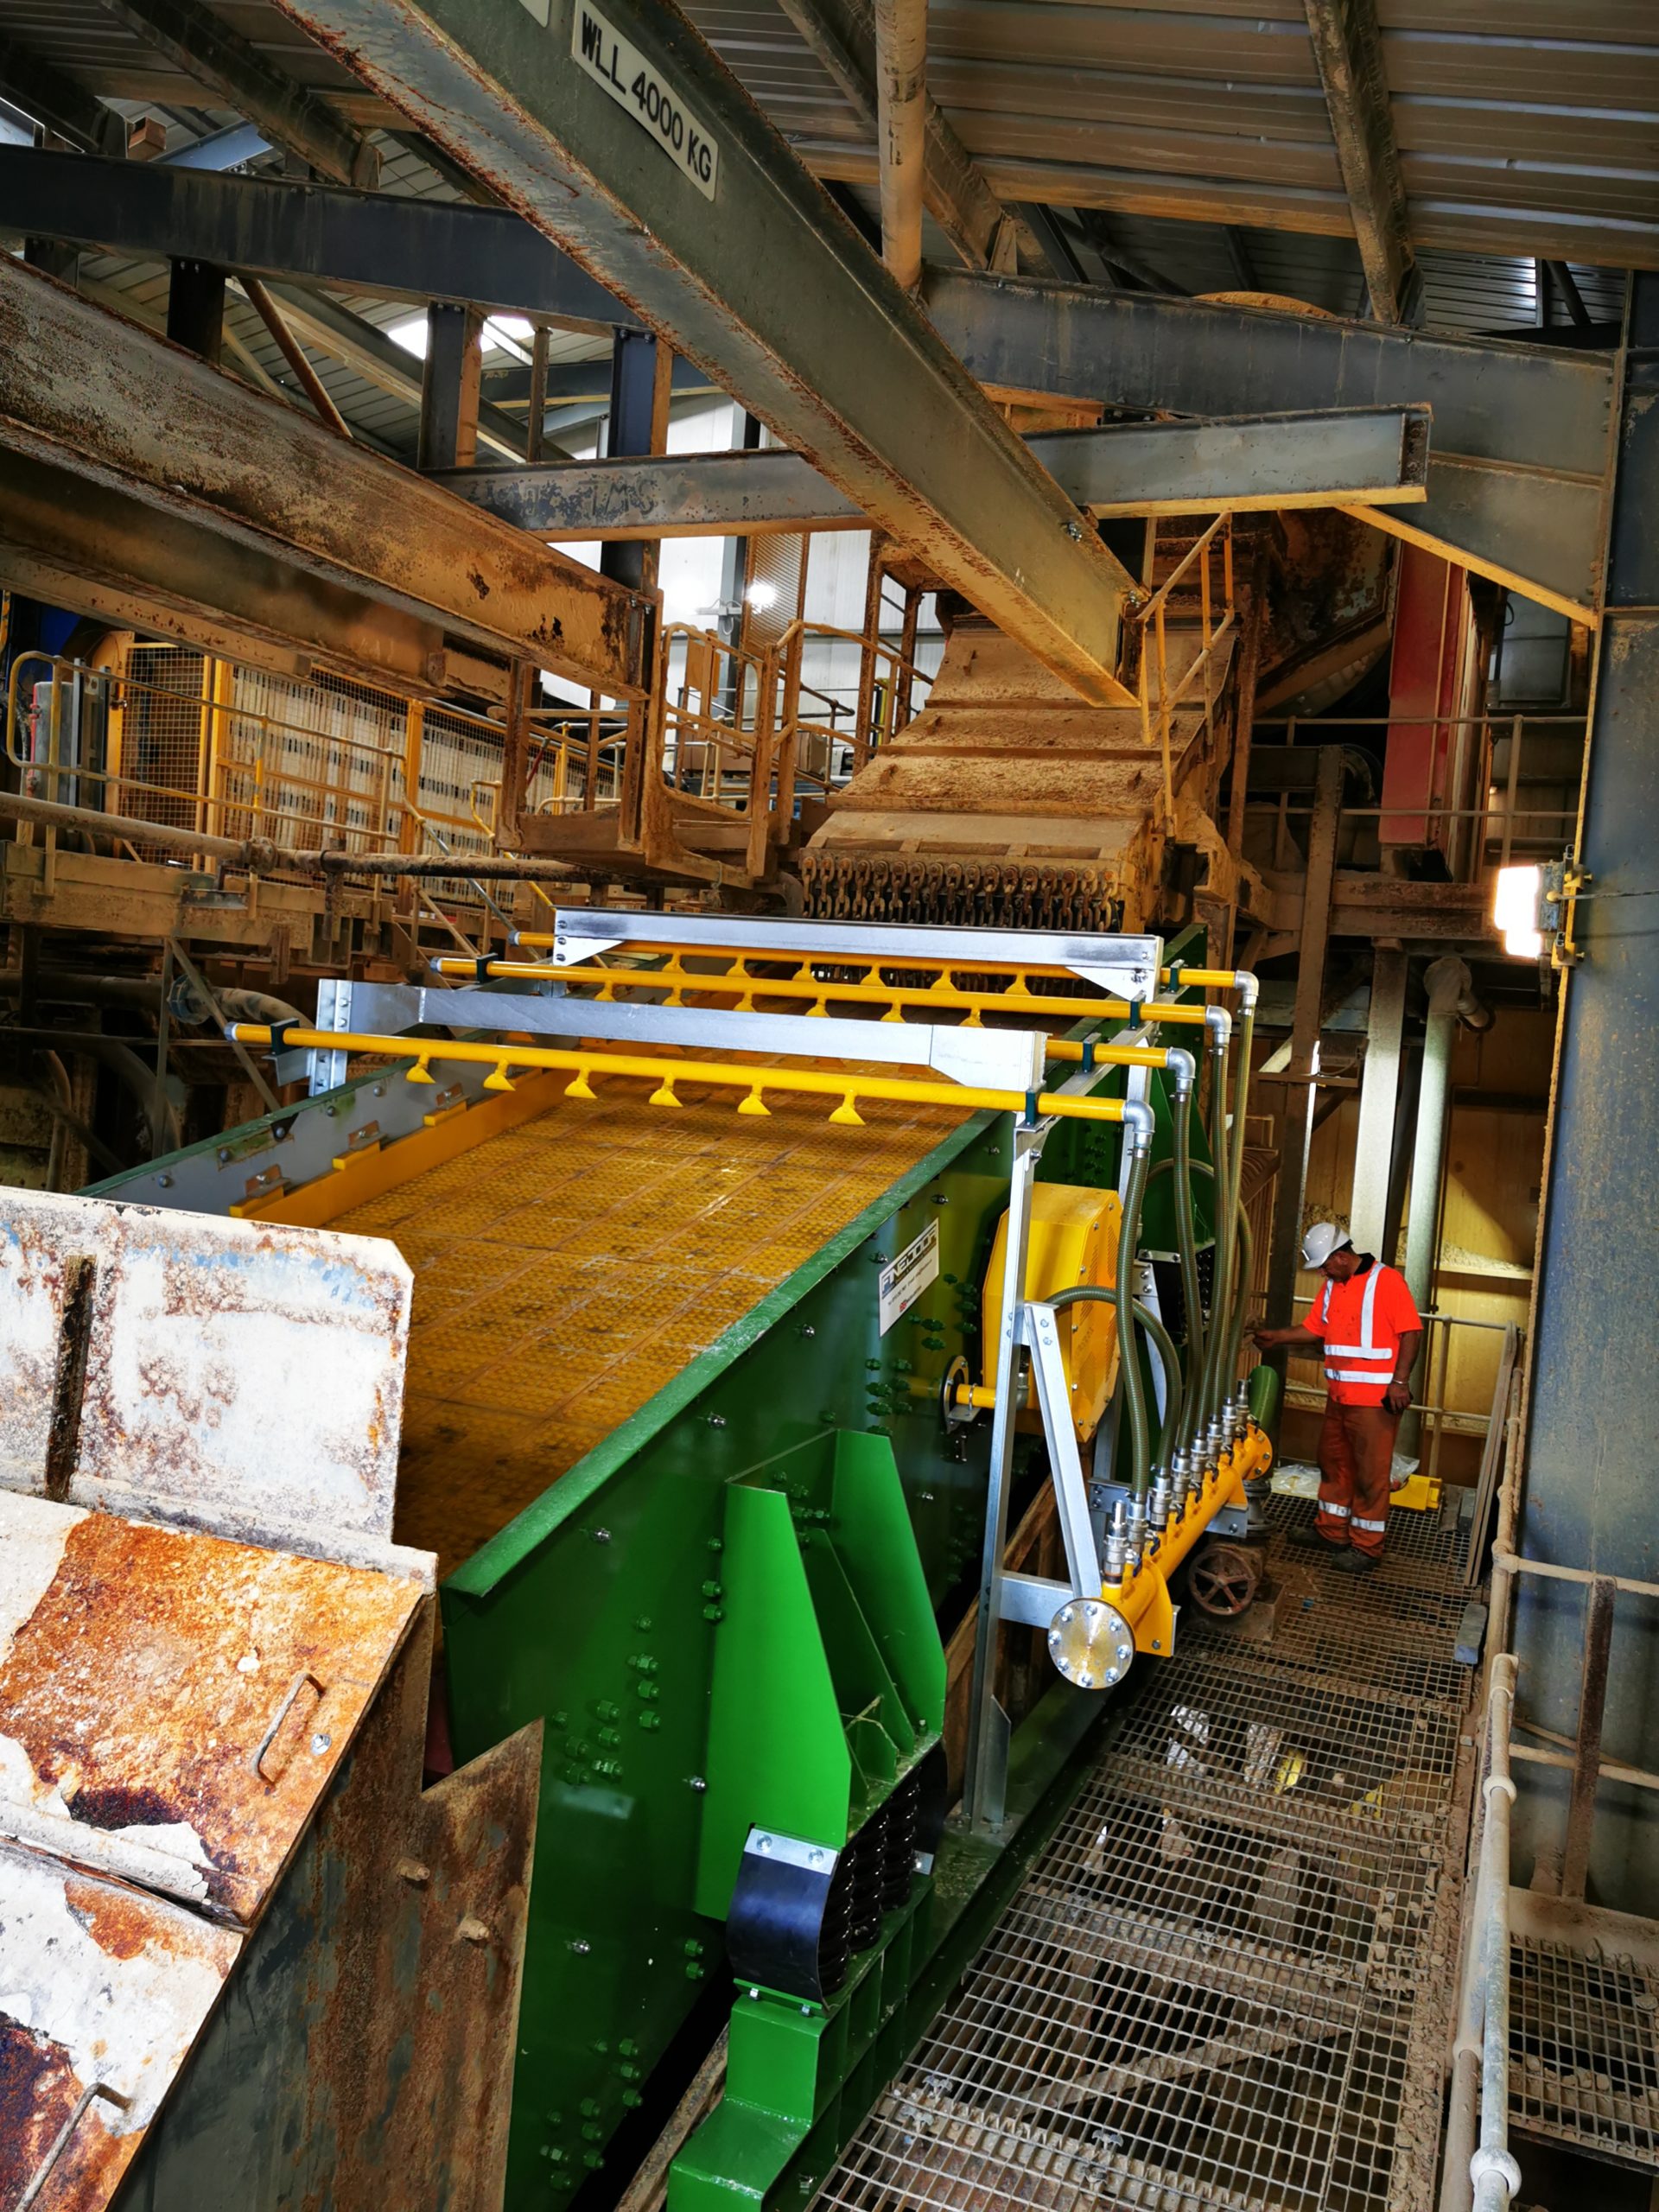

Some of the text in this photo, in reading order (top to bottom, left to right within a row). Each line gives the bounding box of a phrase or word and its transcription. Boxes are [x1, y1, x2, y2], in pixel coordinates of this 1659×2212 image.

[582, 11, 712, 183] WLL 4000 KG
